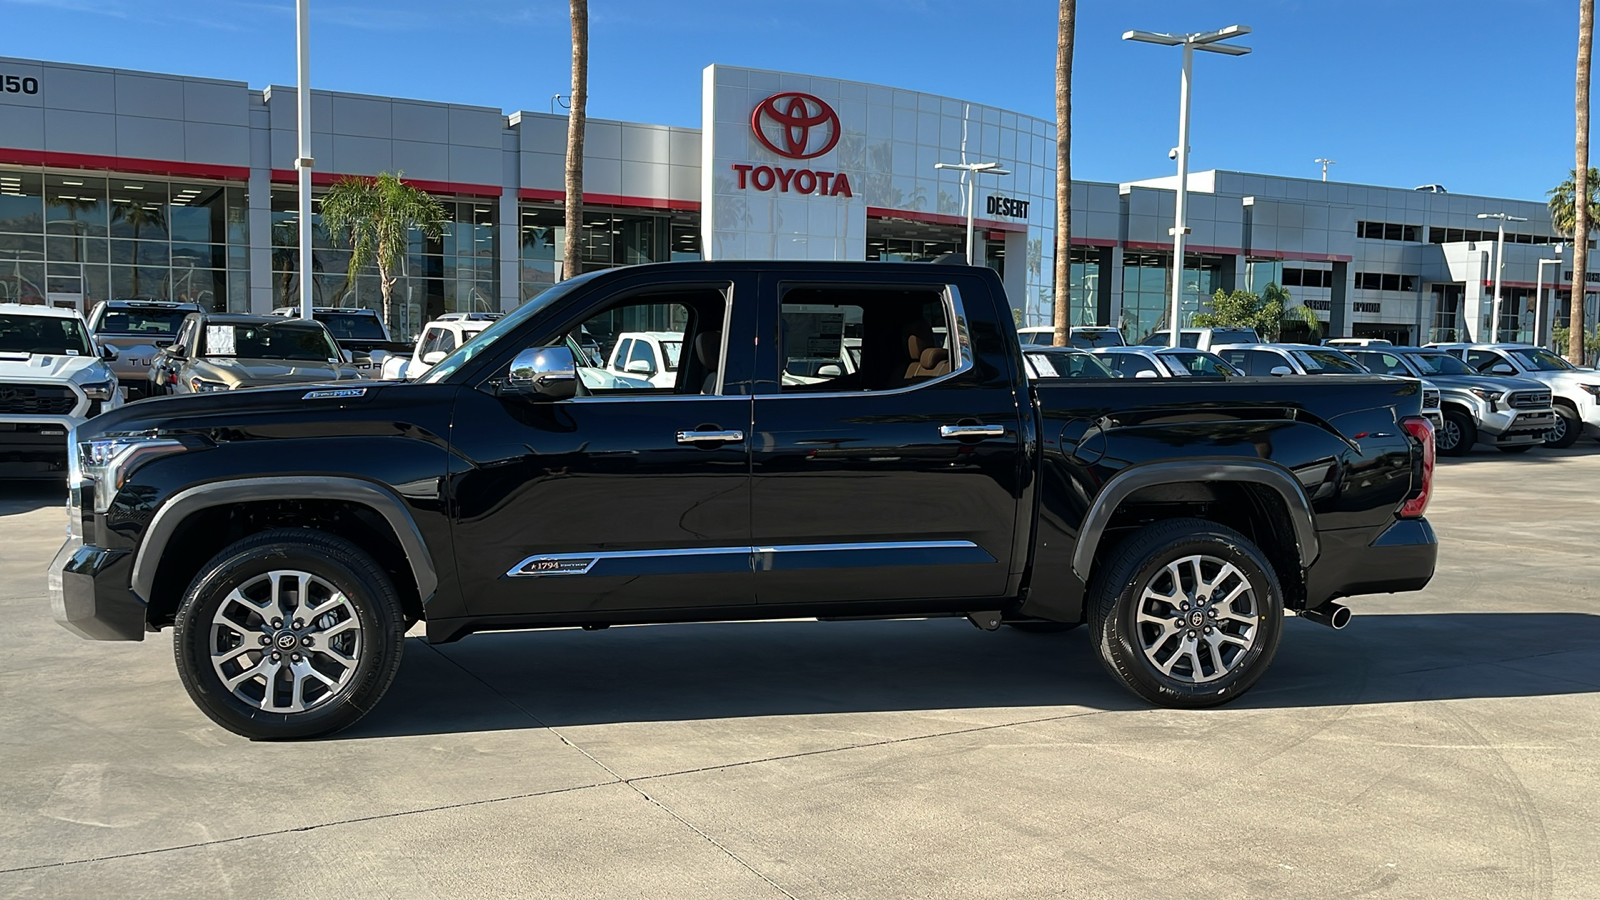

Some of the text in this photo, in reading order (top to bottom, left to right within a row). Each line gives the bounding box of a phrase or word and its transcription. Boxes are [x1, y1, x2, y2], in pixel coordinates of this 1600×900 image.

[732, 164, 853, 198] TOYOTA
[986, 195, 1030, 219] DESERT
[538, 562, 560, 570] 1794
